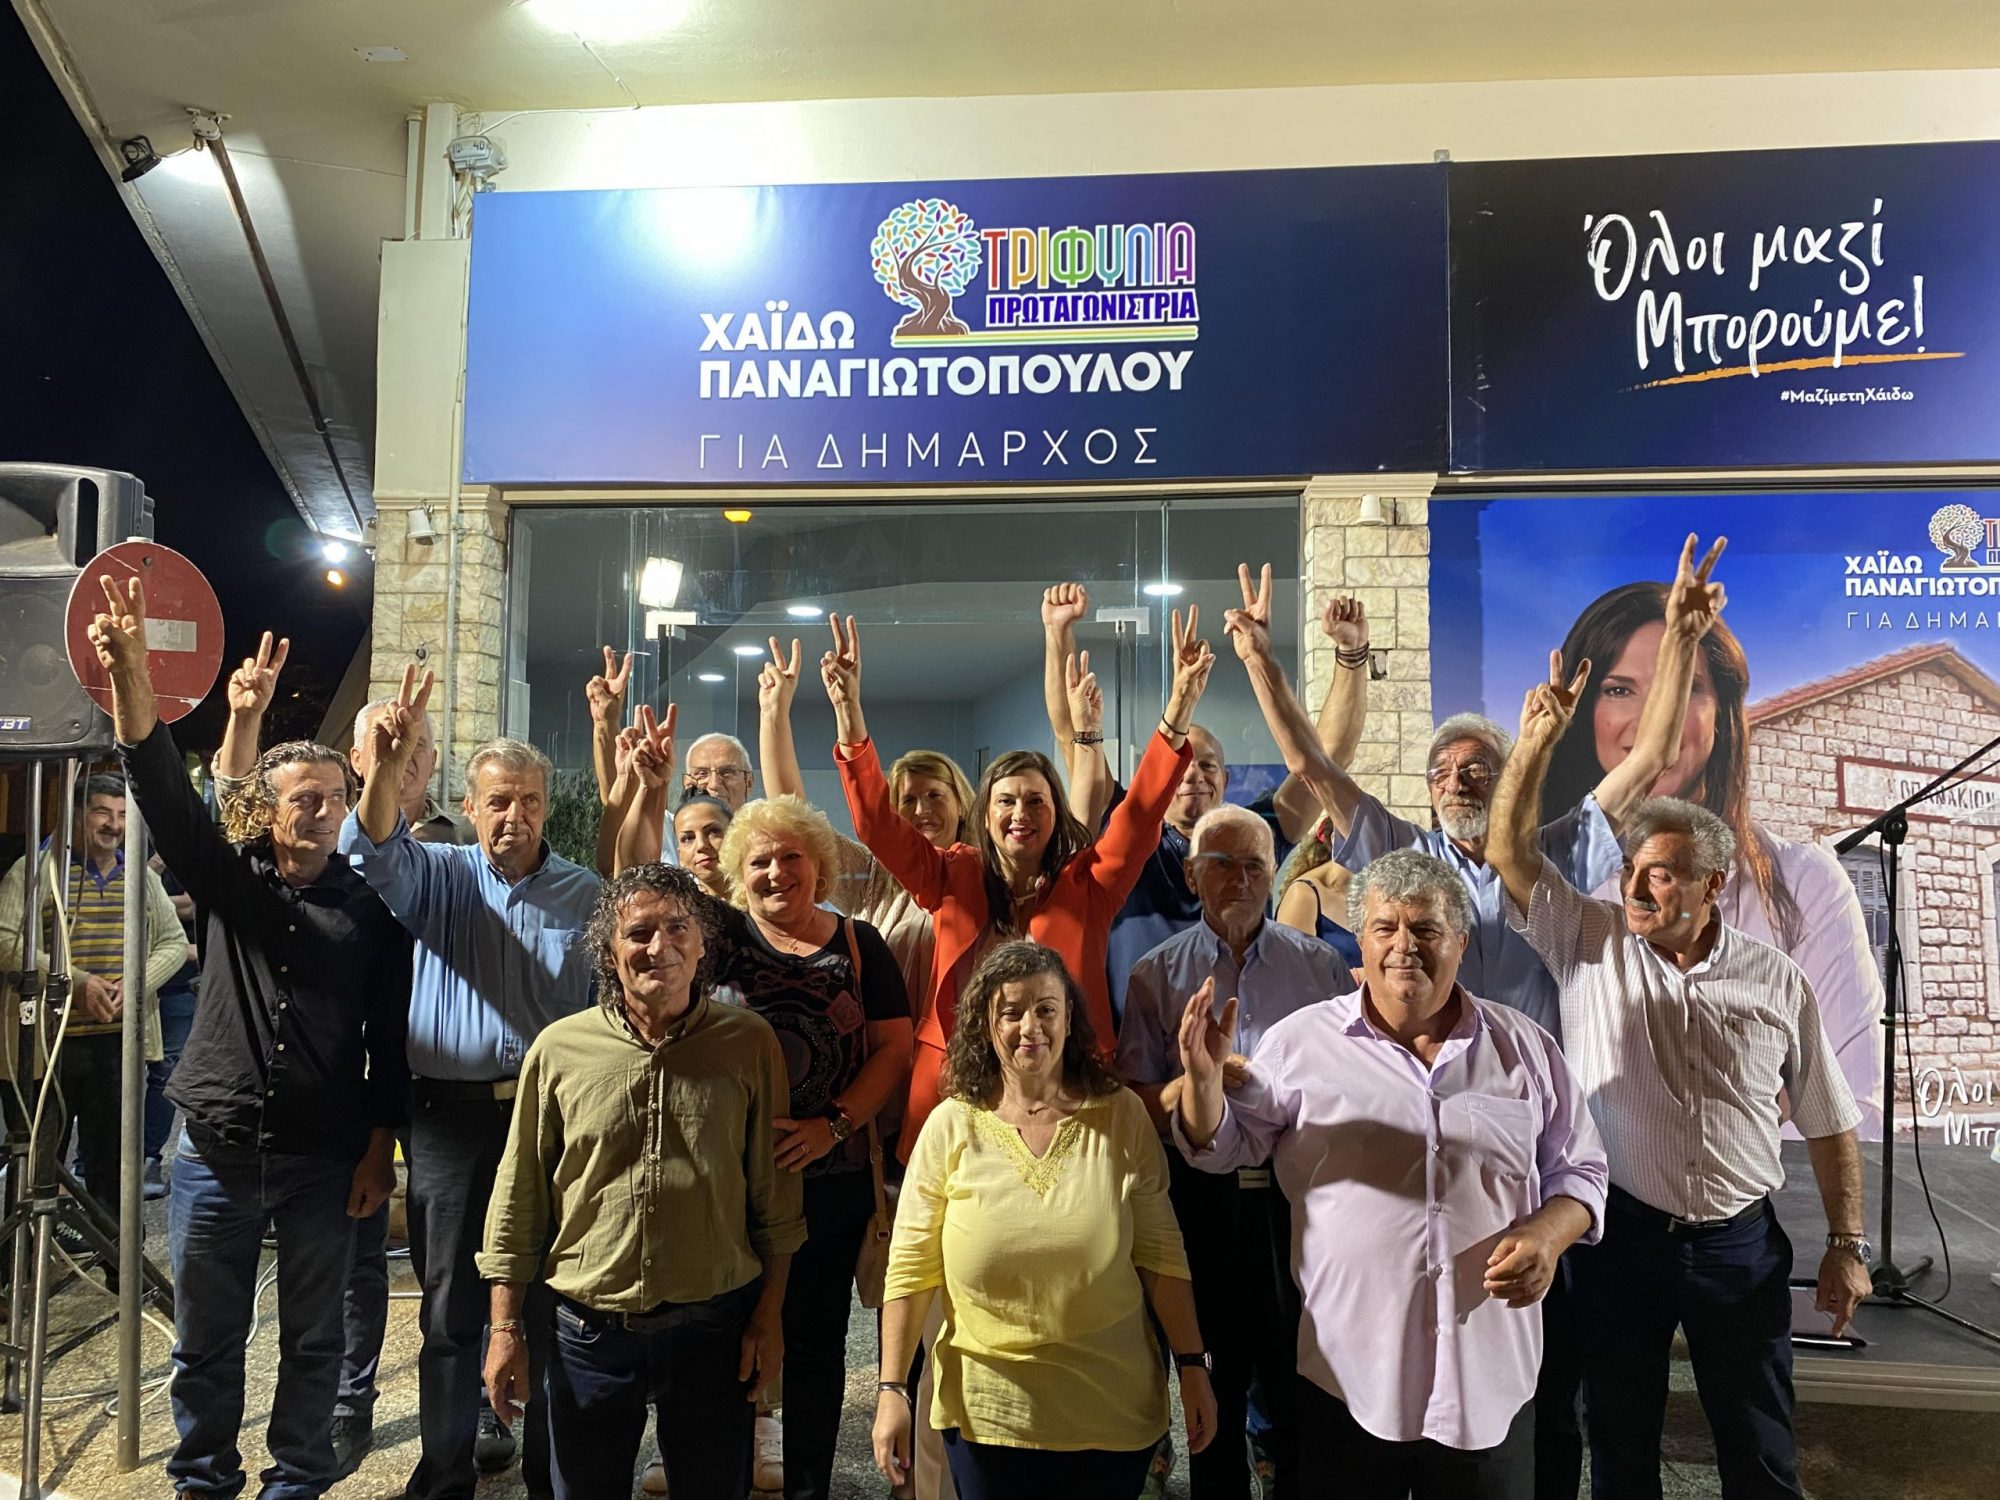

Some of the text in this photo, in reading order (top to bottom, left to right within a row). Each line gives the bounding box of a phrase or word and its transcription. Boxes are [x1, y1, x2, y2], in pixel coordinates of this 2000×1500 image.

[1583, 198, 1884, 301] Όλοι μαζί
[699, 300, 855, 352] ΧΑΪΔΩ
[987, 290, 1198, 326] ΠΡΩΤΑΓΩΝΙΣΤΡΙΑ
[1636, 274, 1926, 378] Μπορούμε!
[699, 351, 1194, 399] ΠΑΝΑΓΙΩΤΟΠΟΥΛΟΥ
[699, 428, 1158, 469] ΓΙΑ ΔΗΜΑΡΧΟΣ
[1844, 550, 1923, 574] ΧΑΪΔΩ
[1847, 611, 2000, 629] ΓΙΑ ΔΗΜΑ
[1914, 1066, 1994, 1118] Όλοι
[1944, 1111, 2000, 1147] Μπ
